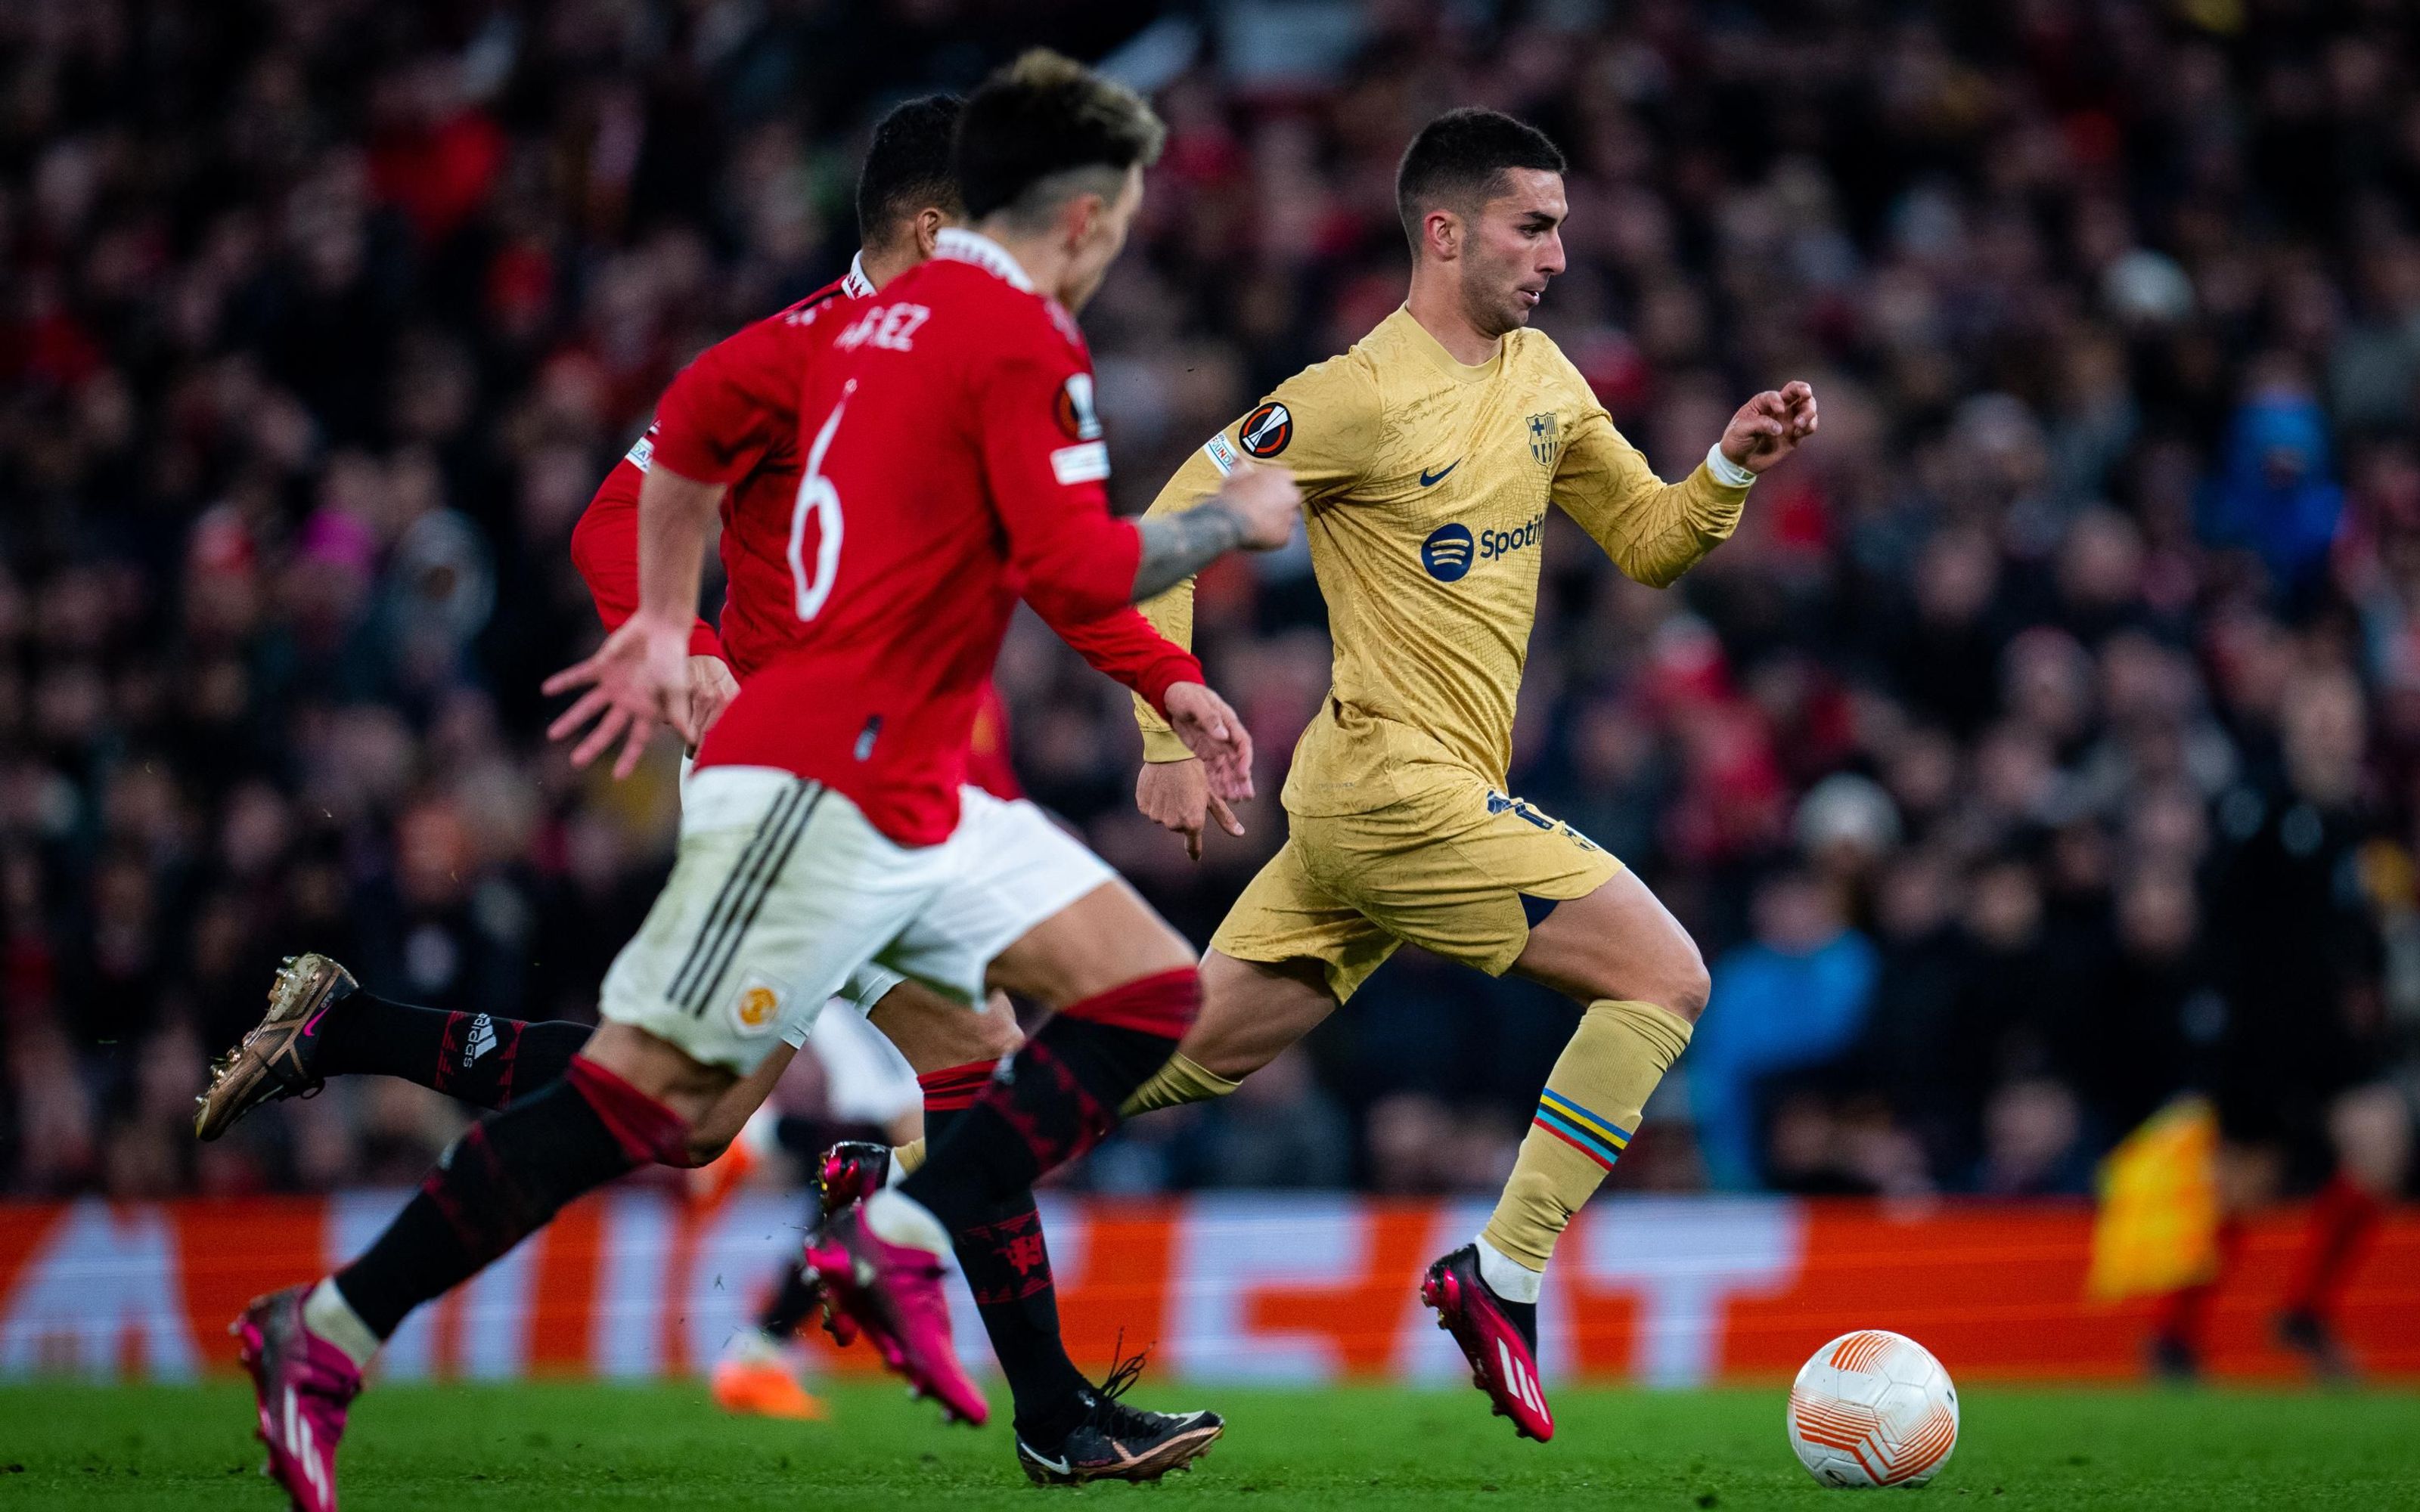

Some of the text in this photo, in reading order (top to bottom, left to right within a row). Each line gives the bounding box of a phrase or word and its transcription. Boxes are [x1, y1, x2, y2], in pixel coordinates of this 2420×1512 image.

[787, 378, 858, 621] 6
[1481, 513, 1544, 561] Spotif
[463, 1012, 489, 1068] adidas
